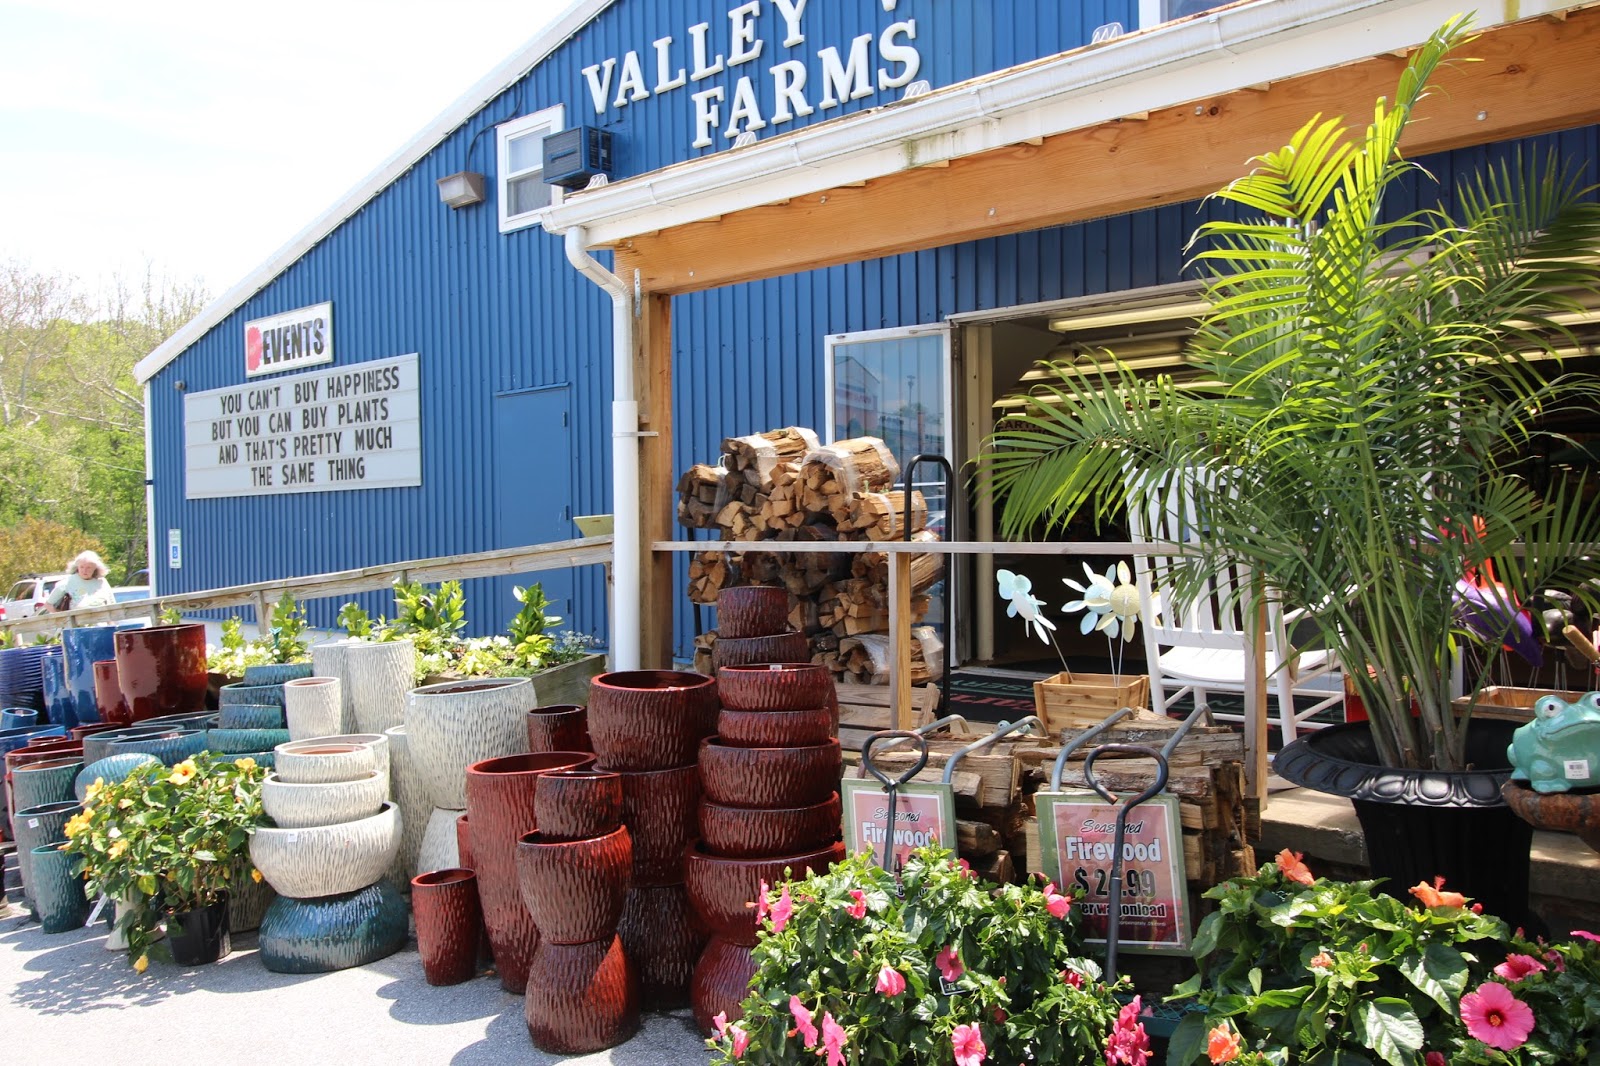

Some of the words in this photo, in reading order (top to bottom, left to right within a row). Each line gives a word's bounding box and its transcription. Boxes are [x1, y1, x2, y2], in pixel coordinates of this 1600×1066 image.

[582, 0, 807, 114] VALLEY
[691, 19, 921, 149] FARMS
[262, 317, 325, 365] EVENTS
[220, 393, 242, 415] YOU
[248, 386, 281, 411] CAN'T
[294, 380, 319, 404] BUY
[327, 366, 400, 399] HAPPINESS
[212, 420, 232, 441] BUT
[237, 416, 260, 437] YOU
[269, 411, 292, 433] CAN
[302, 406, 328, 429] BUY
[338, 398, 388, 425] PLANTS
[218, 444, 239, 465] AND
[245, 438, 287, 461] THAT'S
[293, 432, 342, 457] PRETTY
[354, 426, 393, 451] MUCH
[251, 466, 273, 487] THE
[282, 462, 315, 485] SAME
[328, 457, 365, 481] THING
[873, 807, 923, 823] Sesoned
[1080, 819, 1145, 835] Seasned
